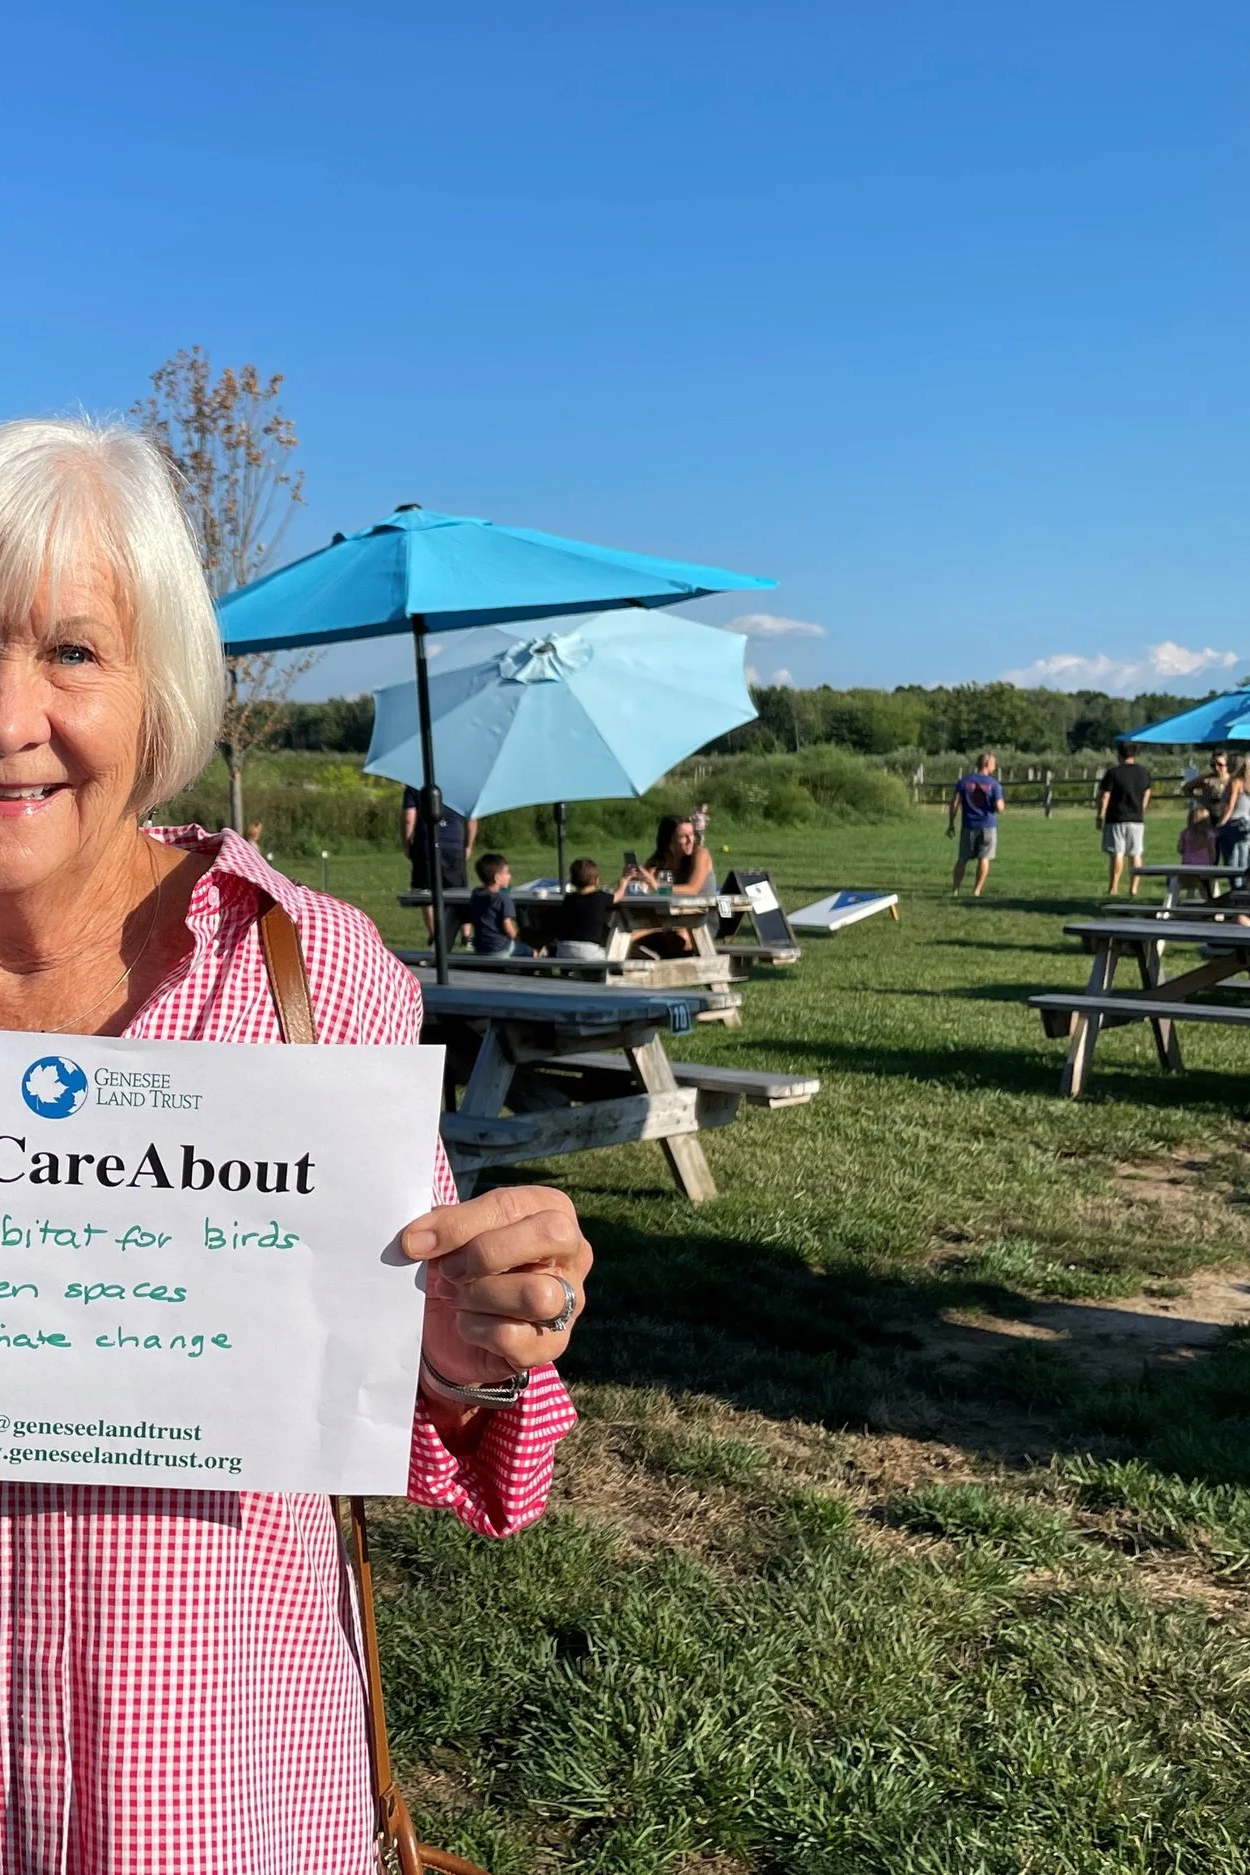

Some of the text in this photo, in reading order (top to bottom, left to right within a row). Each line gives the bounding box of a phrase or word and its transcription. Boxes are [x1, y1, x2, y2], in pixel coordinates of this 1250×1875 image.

[93, 1067, 171, 1089] GENESEE
[96, 1087, 203, 1110] LAND TRUST
[114, 1225, 173, 1251] for
[63, 1281, 188, 1306] spaces
[95, 1325, 233, 1358] change
